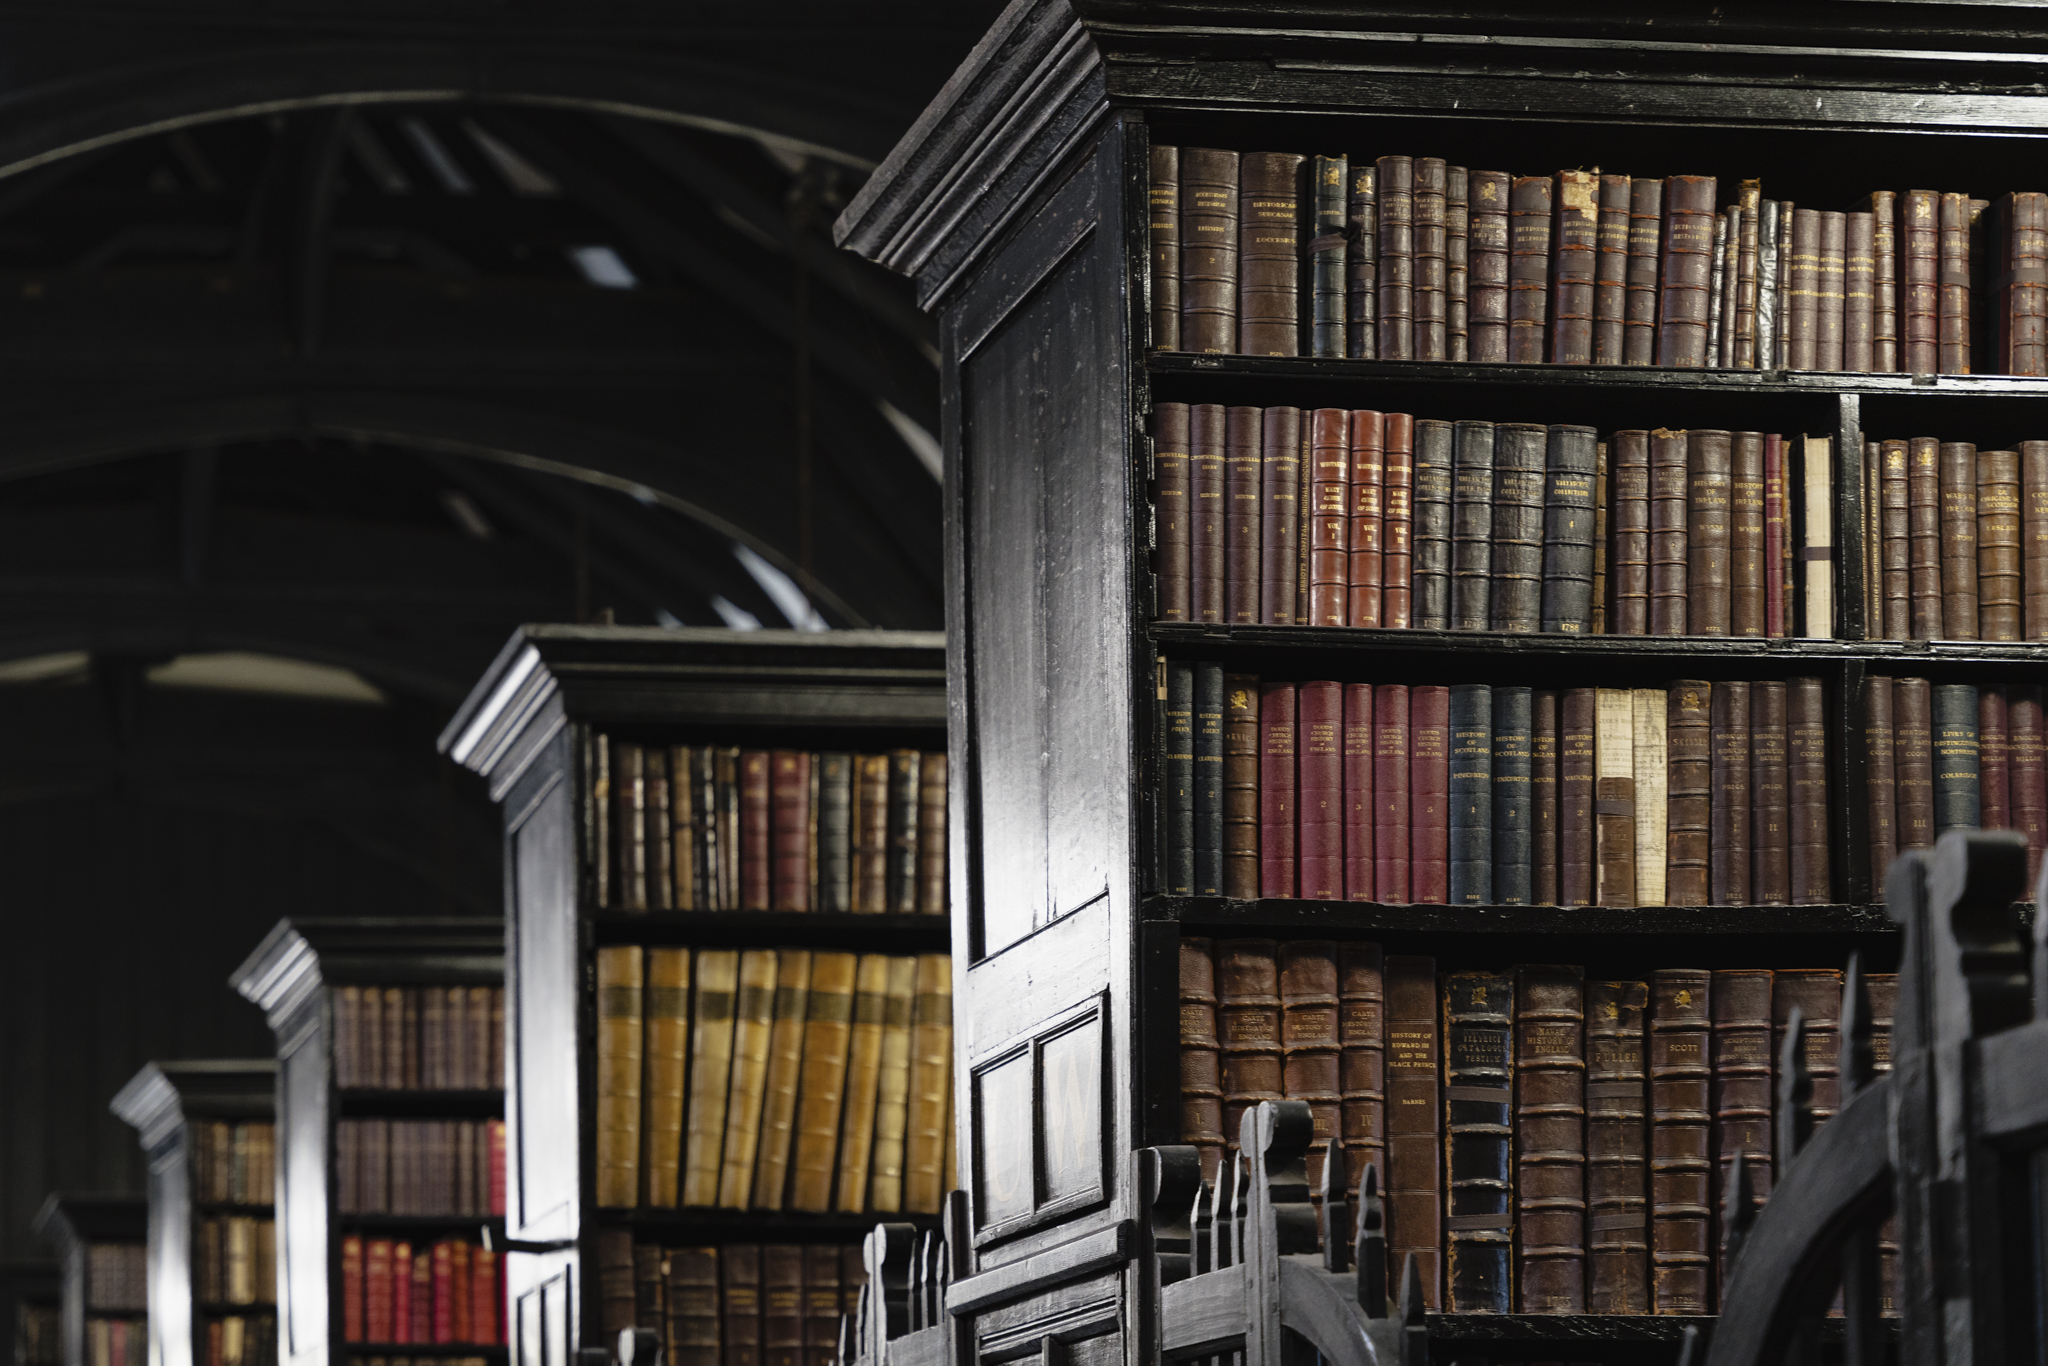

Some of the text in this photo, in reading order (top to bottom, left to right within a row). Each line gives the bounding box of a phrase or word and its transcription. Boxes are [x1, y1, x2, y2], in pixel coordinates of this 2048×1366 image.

[1695, 496, 1726, 504] IRELAND
[1735, 498, 1764, 506] IRELAND
[1569, 520, 1574, 528] 4
[1208, 790, 1214, 798] 2
[1389, 804, 1394, 812] 4
[1427, 806, 1433, 814] 5
[1509, 809, 1515, 817] 2
[1914, 819, 1926, 827] III
[1298, 1031, 1330, 1039] ENGLAND
[1537, 1027, 1565, 1036] NAVAL
[1463, 1035, 1501, 1043] ILLYRICI
[1527, 1036, 1575, 1045] HISTORY OF
[1457, 1044, 1506, 1053] CATALOGUS
[1535, 1045, 1570, 1054] ENGLAND
[1465, 1054, 1501, 1063] TESTIUM
[1595, 1052, 1638, 1063] FULLER
[1747, 1131, 1751, 1143] I
